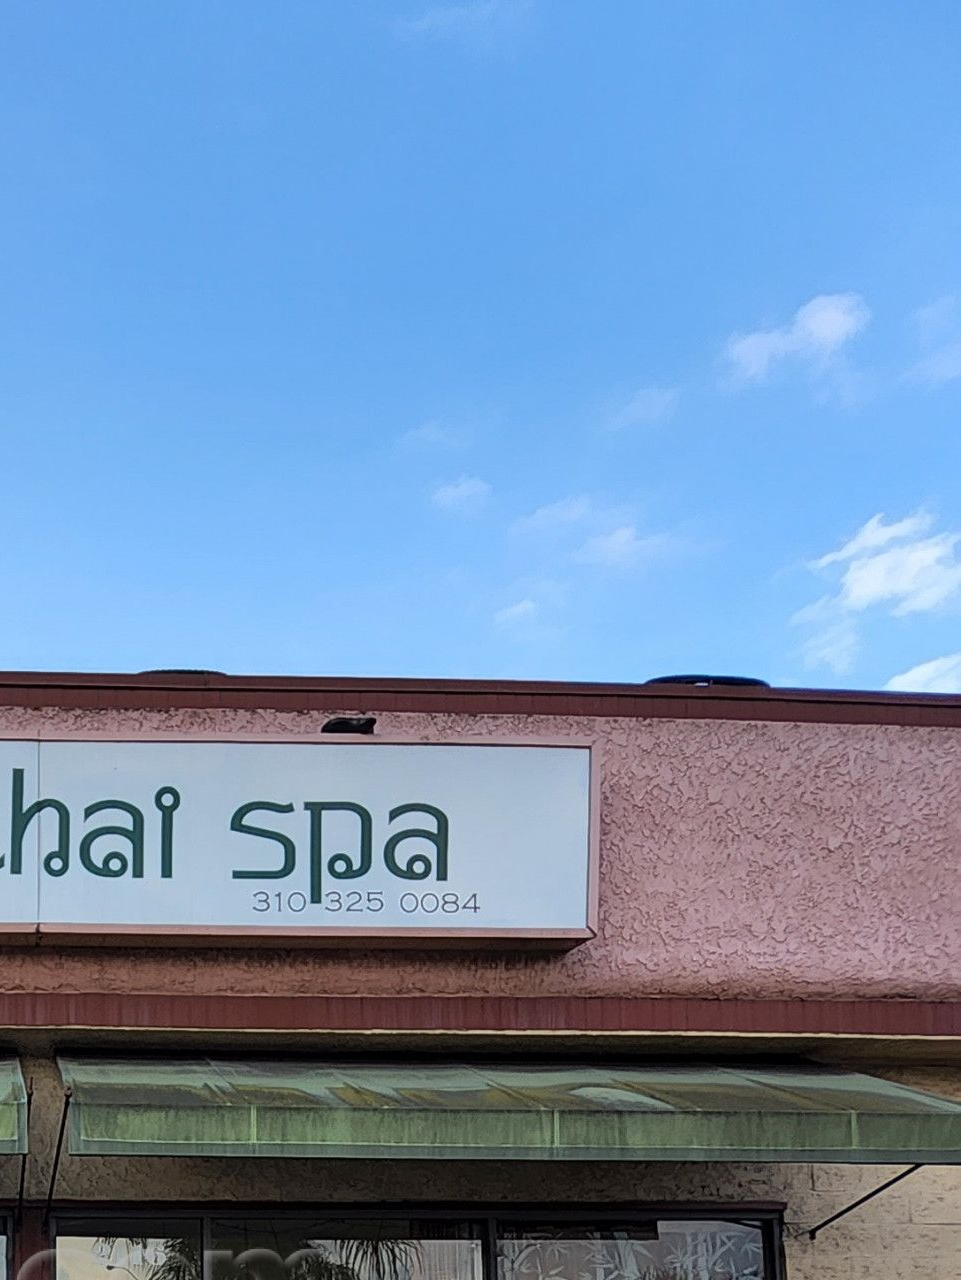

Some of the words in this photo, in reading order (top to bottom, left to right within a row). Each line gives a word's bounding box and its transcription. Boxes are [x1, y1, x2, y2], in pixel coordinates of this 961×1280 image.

[230, 801, 449, 904] spa
[253, 891, 307, 913] 310
[324, 891, 384, 913] 325
[400, 892, 481, 914] 0084
